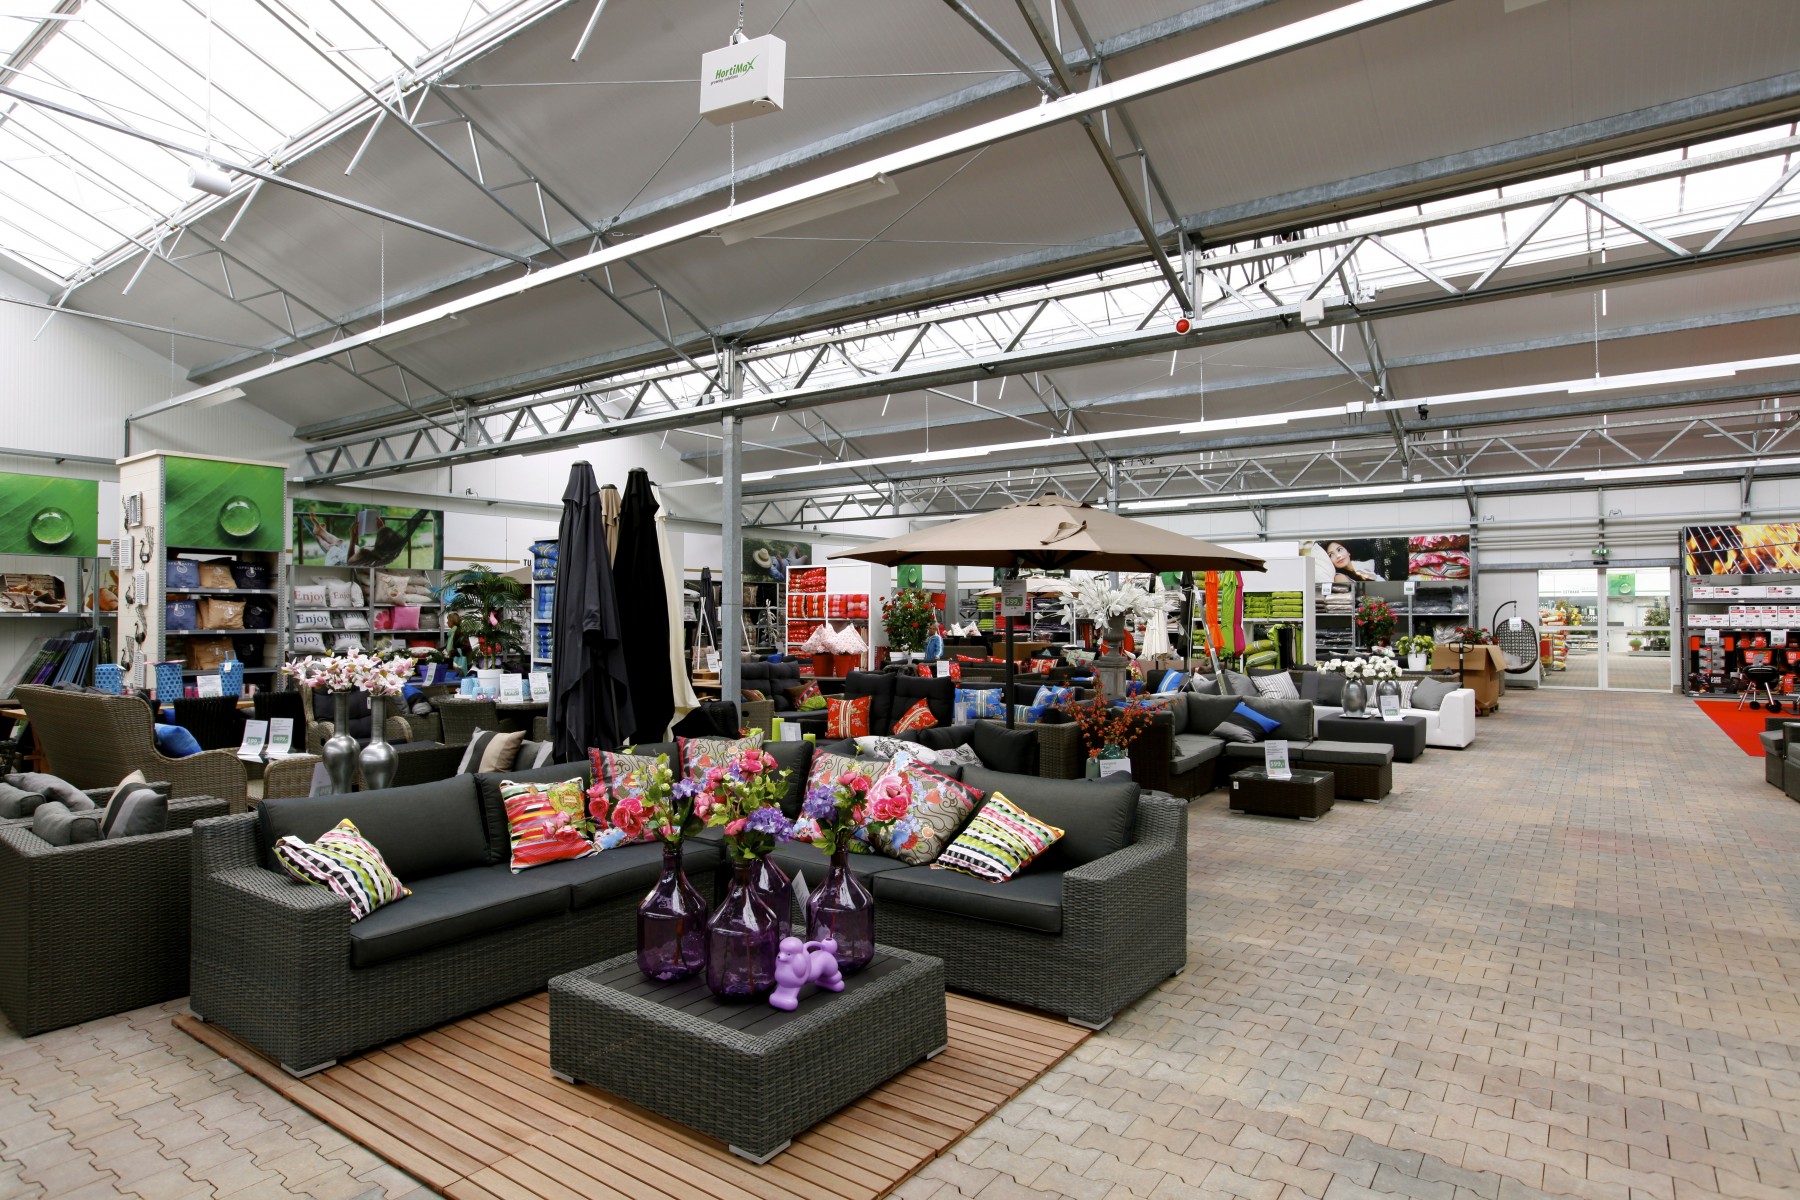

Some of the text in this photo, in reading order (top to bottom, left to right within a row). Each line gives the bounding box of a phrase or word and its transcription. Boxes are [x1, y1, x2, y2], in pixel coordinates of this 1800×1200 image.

[293, 590, 325, 604] Enjoy
[333, 591, 351, 601] Enjo
[296, 613, 330, 626] Enjoy
[294, 634, 321, 646] njoy
